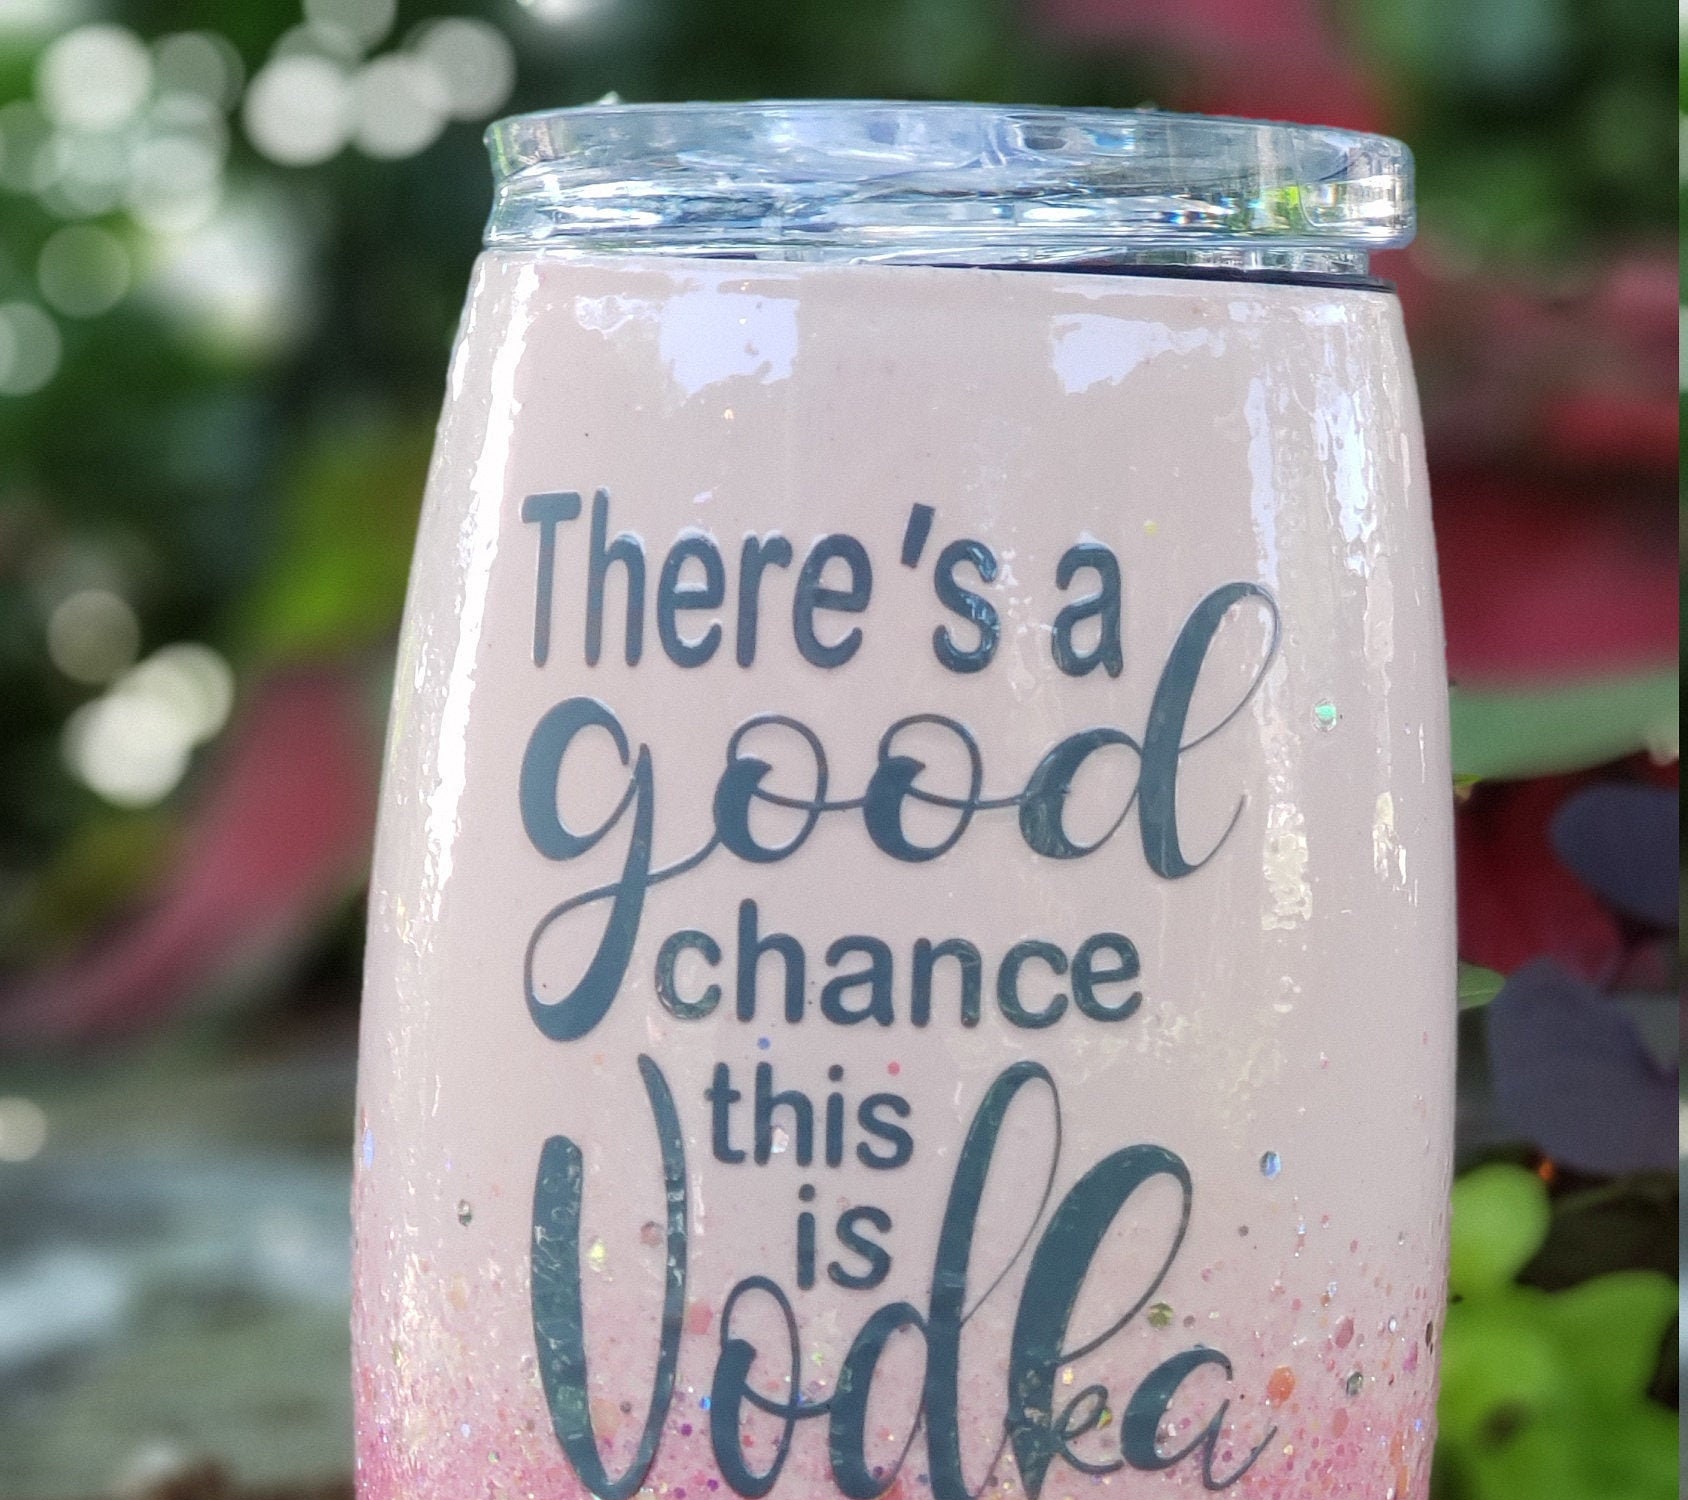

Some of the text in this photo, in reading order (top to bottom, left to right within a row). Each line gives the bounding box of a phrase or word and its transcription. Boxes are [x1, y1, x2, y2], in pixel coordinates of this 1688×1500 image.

[521, 487, 1122, 677] There's a
[519, 581, 1281, 1042] good
[655, 898, 1144, 1028] chance
[705, 1061, 915, 1169] this
[798, 1184, 893, 1290] is
